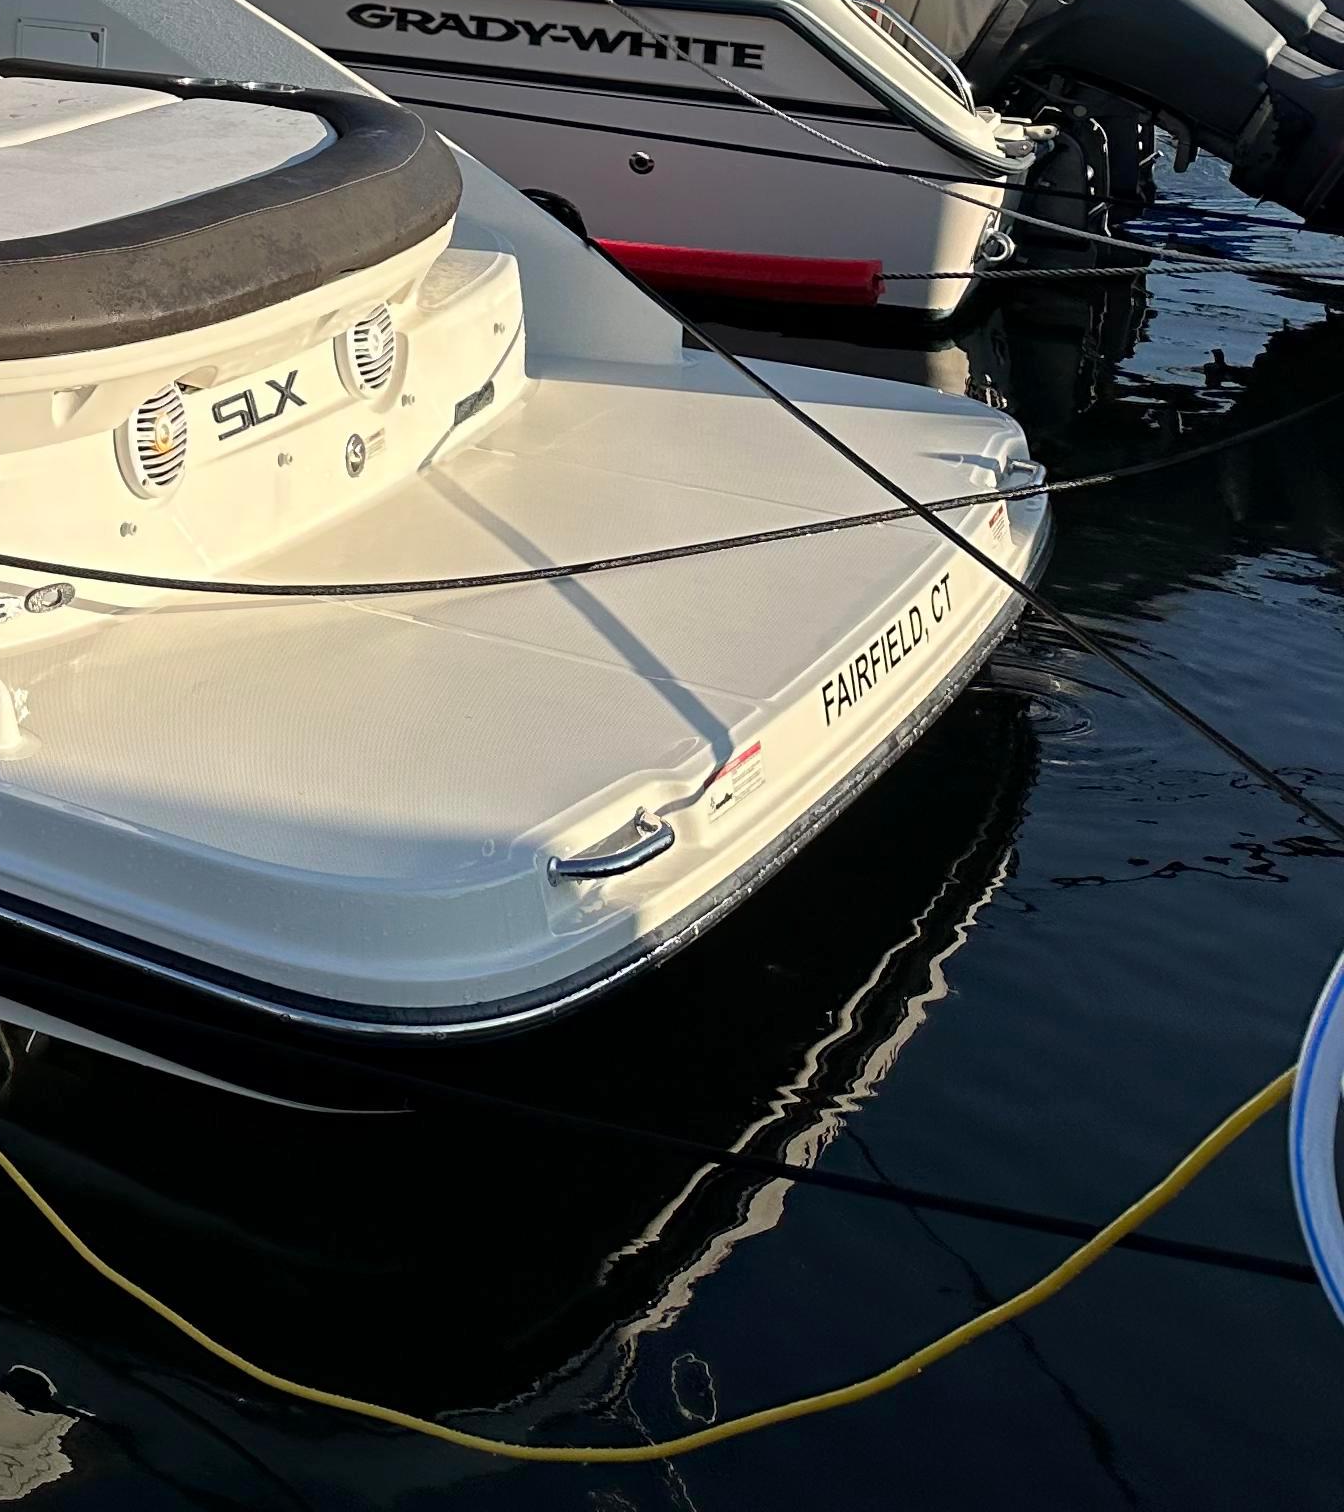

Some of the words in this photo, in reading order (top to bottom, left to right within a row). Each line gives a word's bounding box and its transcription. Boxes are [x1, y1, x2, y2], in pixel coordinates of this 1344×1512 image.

[346, 3, 765, 70] GRADY-WHITE
[212, 369, 307, 441] SLX
[822, 606, 929, 727] FAIRFIELD,
[931, 572, 952, 624] CT
